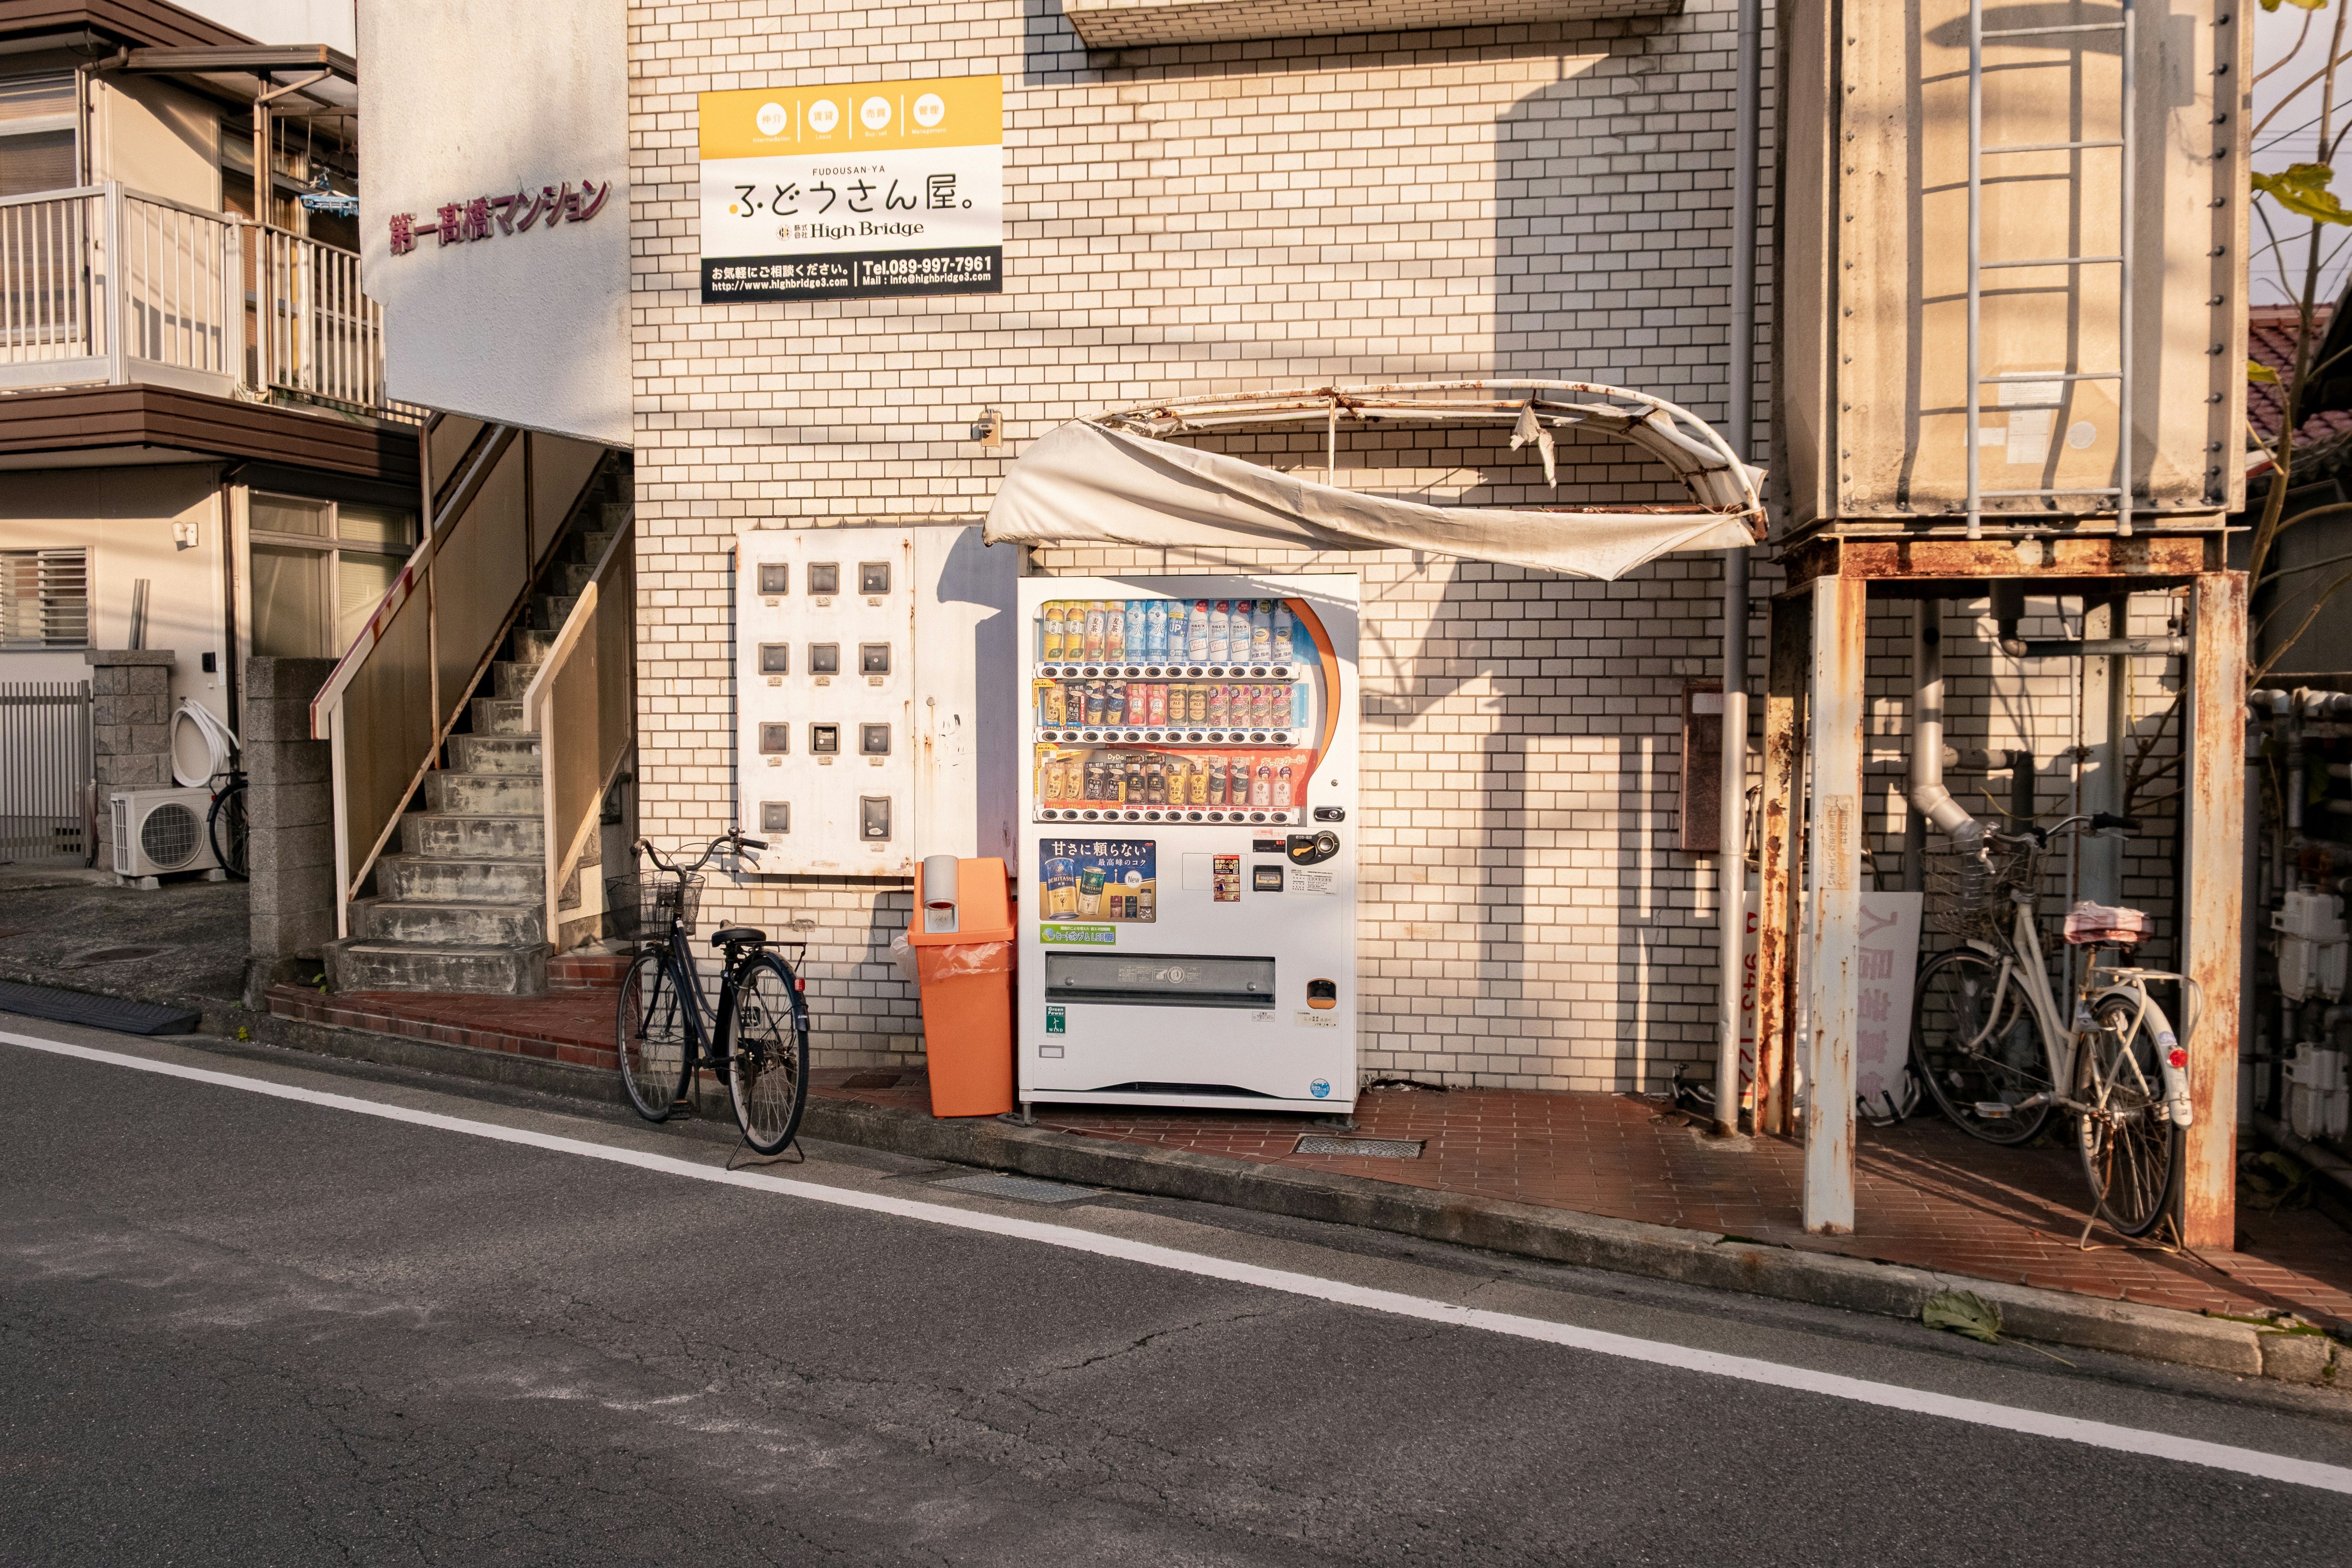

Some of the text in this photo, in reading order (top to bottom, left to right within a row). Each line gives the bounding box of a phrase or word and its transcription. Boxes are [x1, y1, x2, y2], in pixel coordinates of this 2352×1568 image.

[814, 111, 833, 121] 賃貸
[866, 108, 885, 118] 売買
[919, 105, 939, 115] 管理
[762, 113, 781, 124] 仲介
[813, 165, 885, 176] FUDOUSAN-YA
[810, 223, 856, 240] High
[859, 221, 924, 237] Bridge
[712, 263, 848, 280] お気軽にご相談ください。
[712, 278, 849, 292] http://www.highbridge3.com
[890, 272, 991, 285] info@highbridge3.com
[1091, 617, 1099, 633] 麦茶
[1111, 617, 1120, 633] 麦茶
[1129, 622, 1144, 635] 水
[1149, 622, 1165, 635] 水
[1169, 624, 1182, 633] UP
[1052, 841, 1146, 857] 甘さに頼らない
[1098, 859, 1146, 867] 最高峰のコク
[1048, 876, 1074, 884] DEMITASSE
